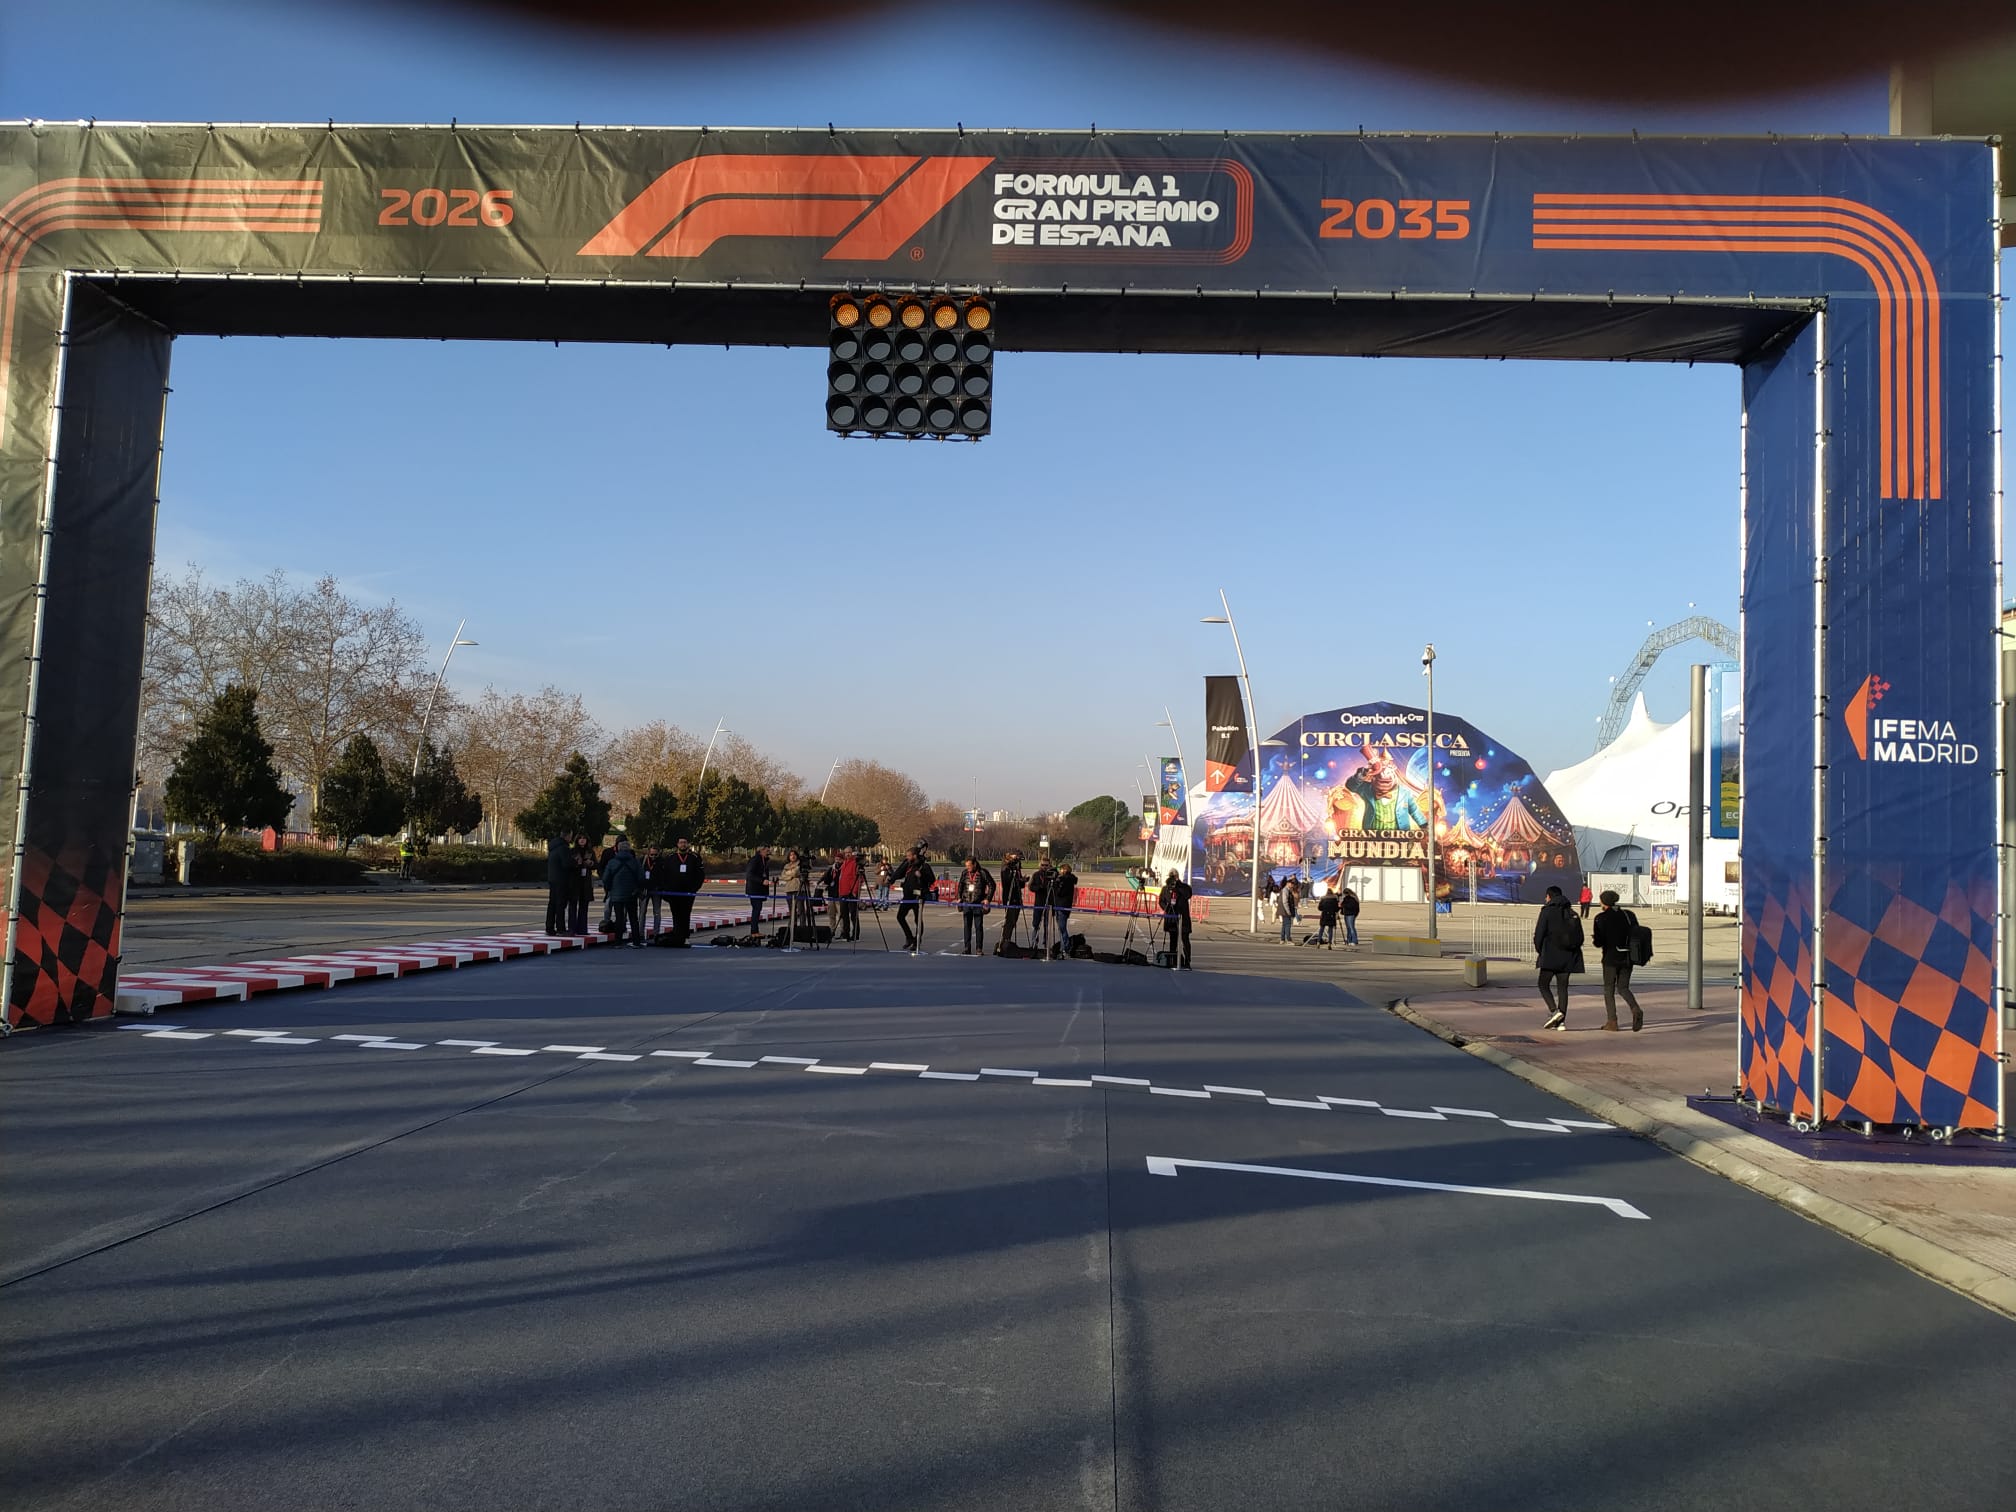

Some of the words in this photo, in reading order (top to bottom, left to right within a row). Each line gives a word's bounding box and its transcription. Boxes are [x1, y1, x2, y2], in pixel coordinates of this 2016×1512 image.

[993, 173, 1156, 197] FORMULA
[1162, 175, 1180, 197] 1
[378, 188, 515, 228] 2026
[993, 198, 1088, 221] GRAN
[1092, 200, 1220, 222] PREMIO
[1319, 198, 1471, 241] 2035
[991, 223, 1035, 245] DE
[1039, 223, 1172, 247] ESPAÑA
[1340, 712, 1408, 727] Openbank
[1874, 718, 1957, 741] IFEMA
[1299, 731, 1470, 750] CIRCLASSCA
[1874, 741, 1979, 764] MADRID
[1338, 828, 1377, 838] GRAN
[1380, 829, 1425, 840] CIRCO
